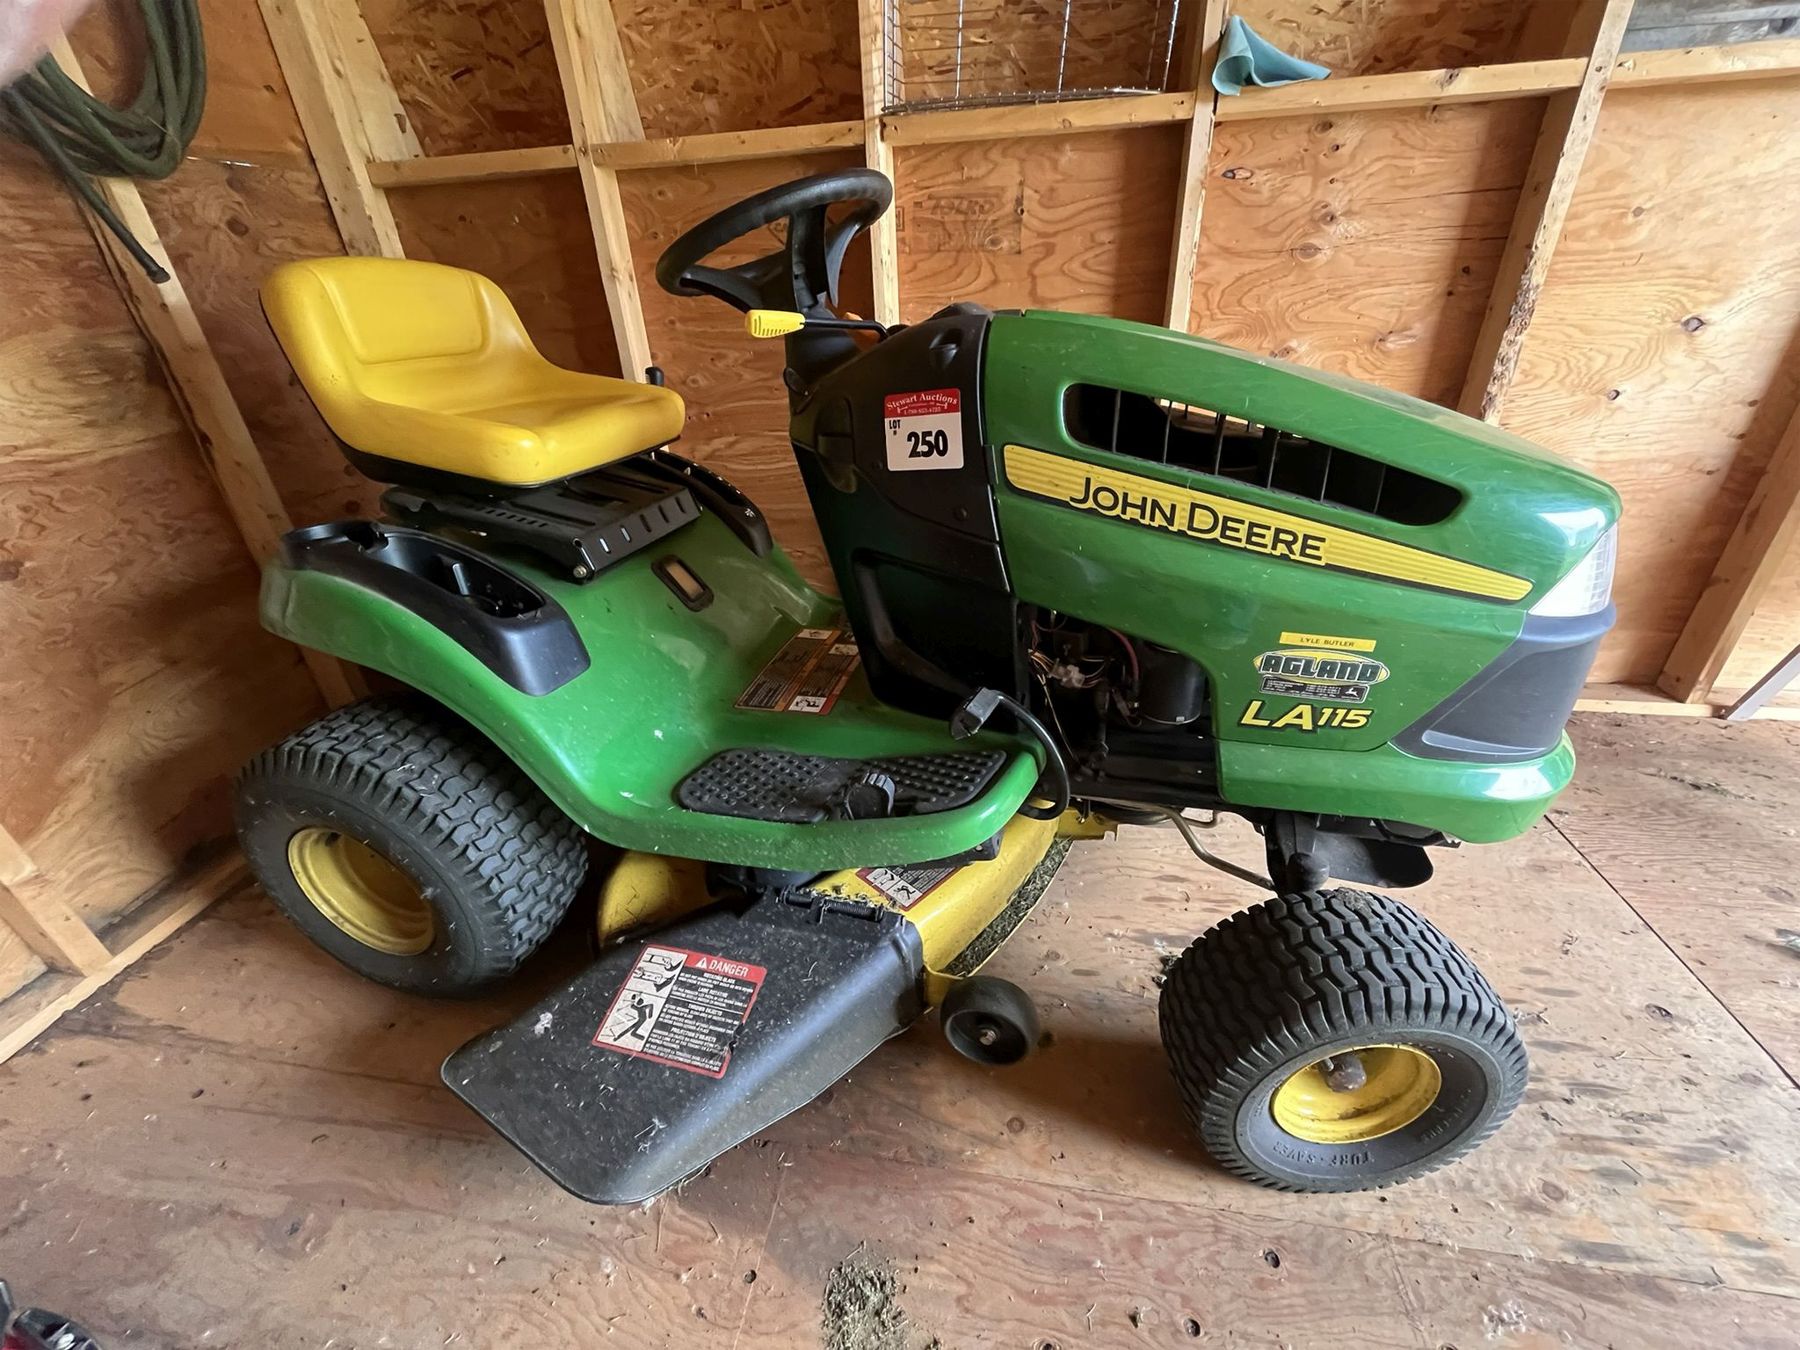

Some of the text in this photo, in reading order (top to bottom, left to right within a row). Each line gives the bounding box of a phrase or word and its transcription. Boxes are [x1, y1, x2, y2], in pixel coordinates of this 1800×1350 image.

[886, 394, 918, 410] Stewart
[919, 393, 958, 405] Auctions
[889, 419, 901, 430] LOT
[906, 429, 949, 459] 250
[1069, 476, 1327, 562] JOHN DEERE
[1300, 637, 1355, 647] LYLE BUTLER
[1260, 653, 1383, 683] AGLAND
[708, 958, 750, 978] DANGER
[1329, 1150, 1372, 1167] TURF
